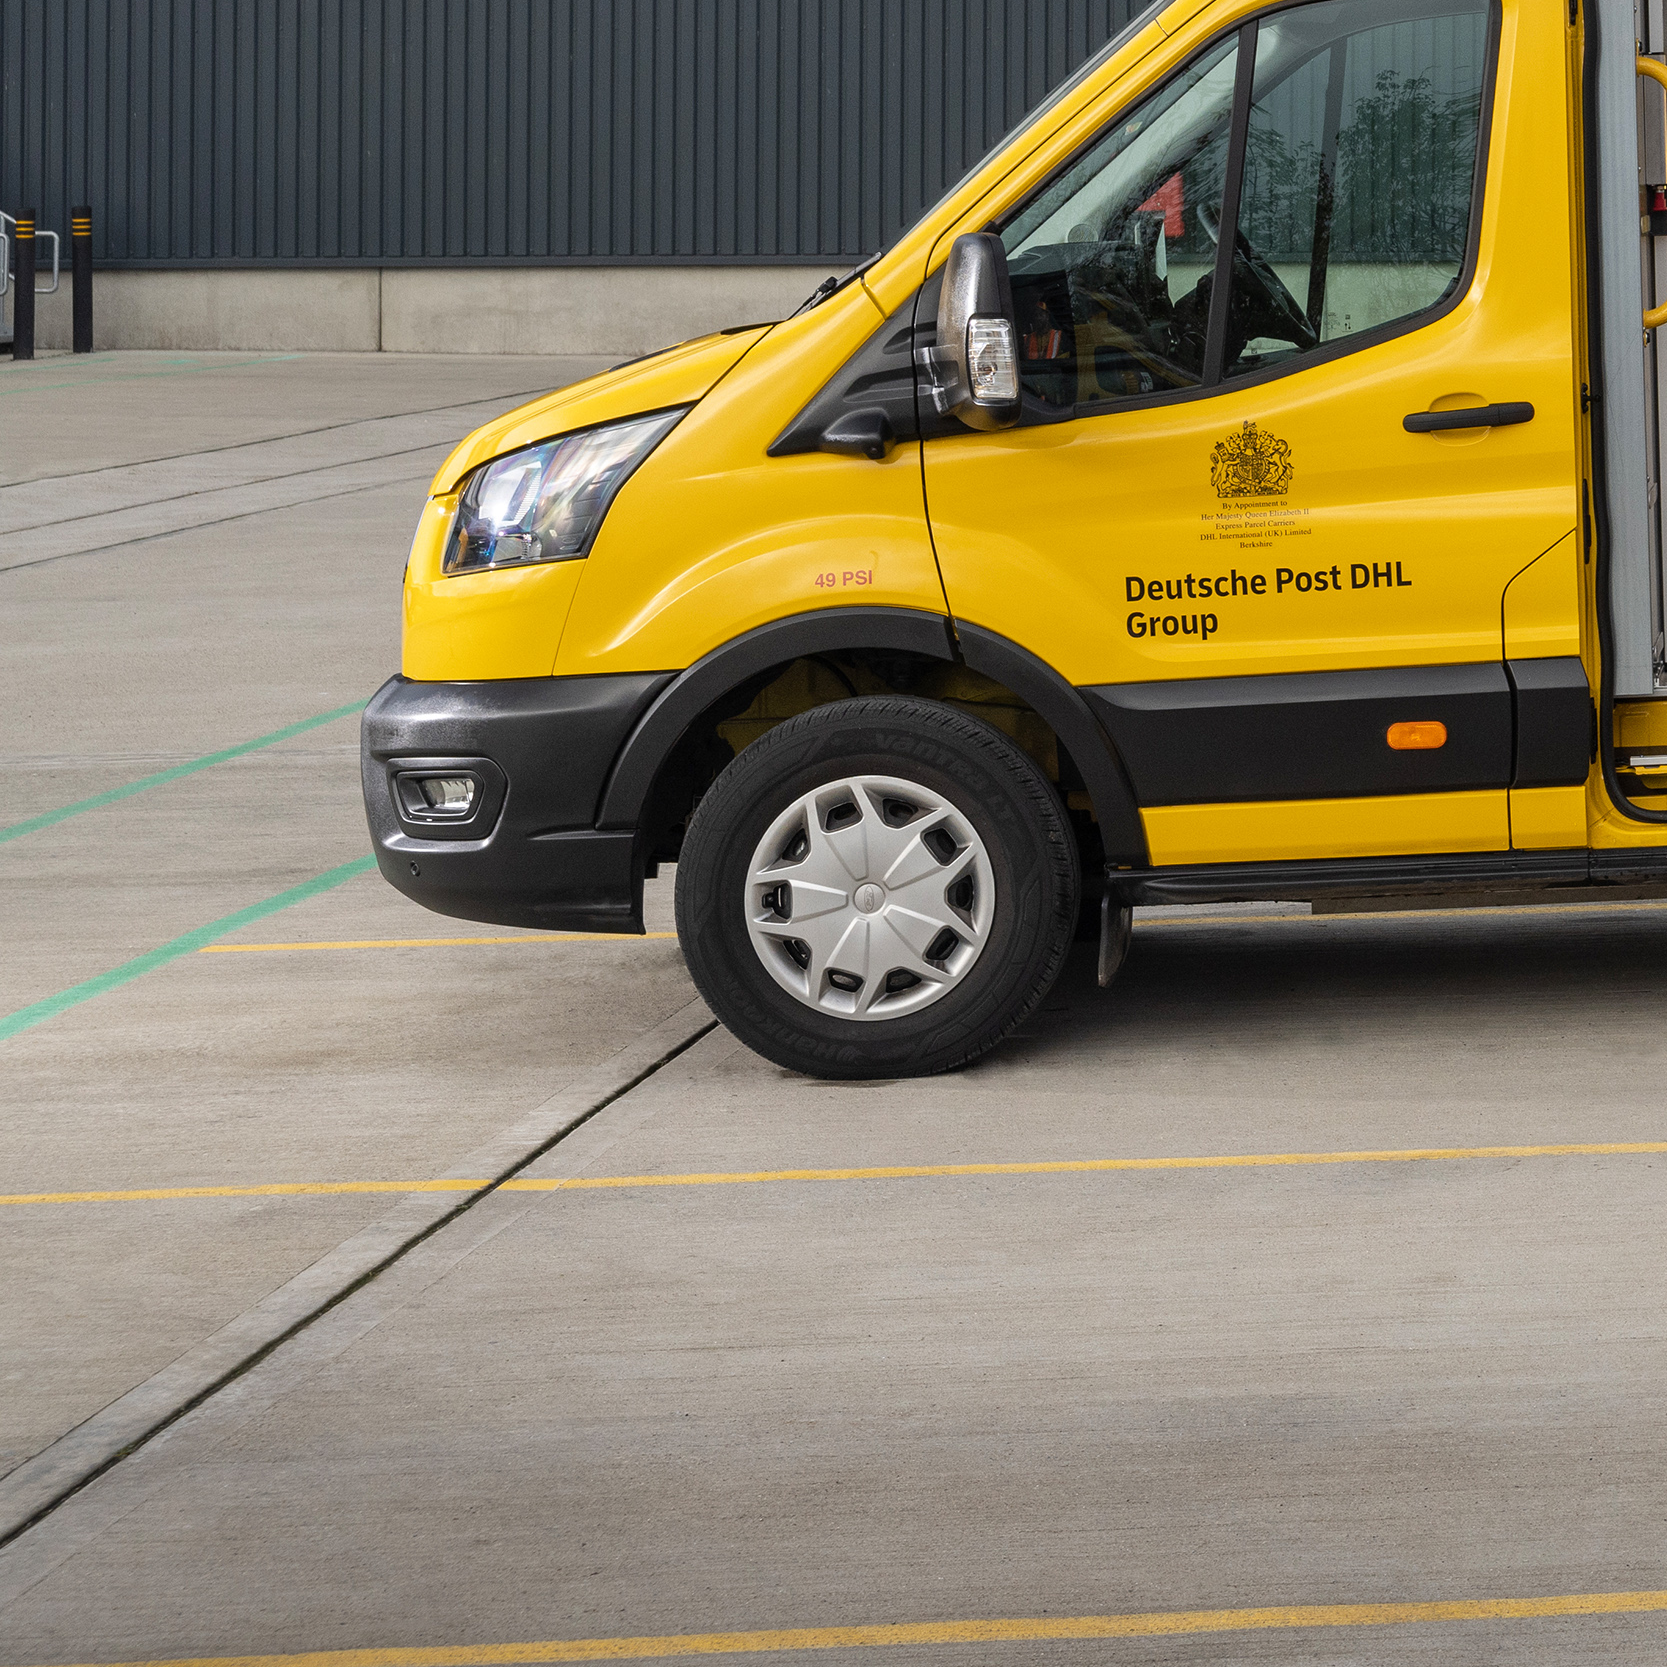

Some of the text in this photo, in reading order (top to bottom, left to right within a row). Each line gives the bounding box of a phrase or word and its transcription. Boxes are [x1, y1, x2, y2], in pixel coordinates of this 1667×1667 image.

[1222, 502, 1232, 511] By
[1234, 500, 1279, 510] Appointment
[1201, 513, 1214, 521] Her
[1216, 512, 1243, 522] Majesty
[1245, 511, 1268, 519] Queen
[1269, 508, 1302, 517] Elizabeth
[1215, 519, 1296, 531] Express Parcel Carriers
[1200, 528, 1312, 541] DHL International (UK) Limited
[1240, 540, 1273, 549] Berkshire
[814, 570, 872, 588] 49 PSI
[1125, 561, 1412, 602] Deutsche Post DHL
[1126, 611, 1218, 640] Group
